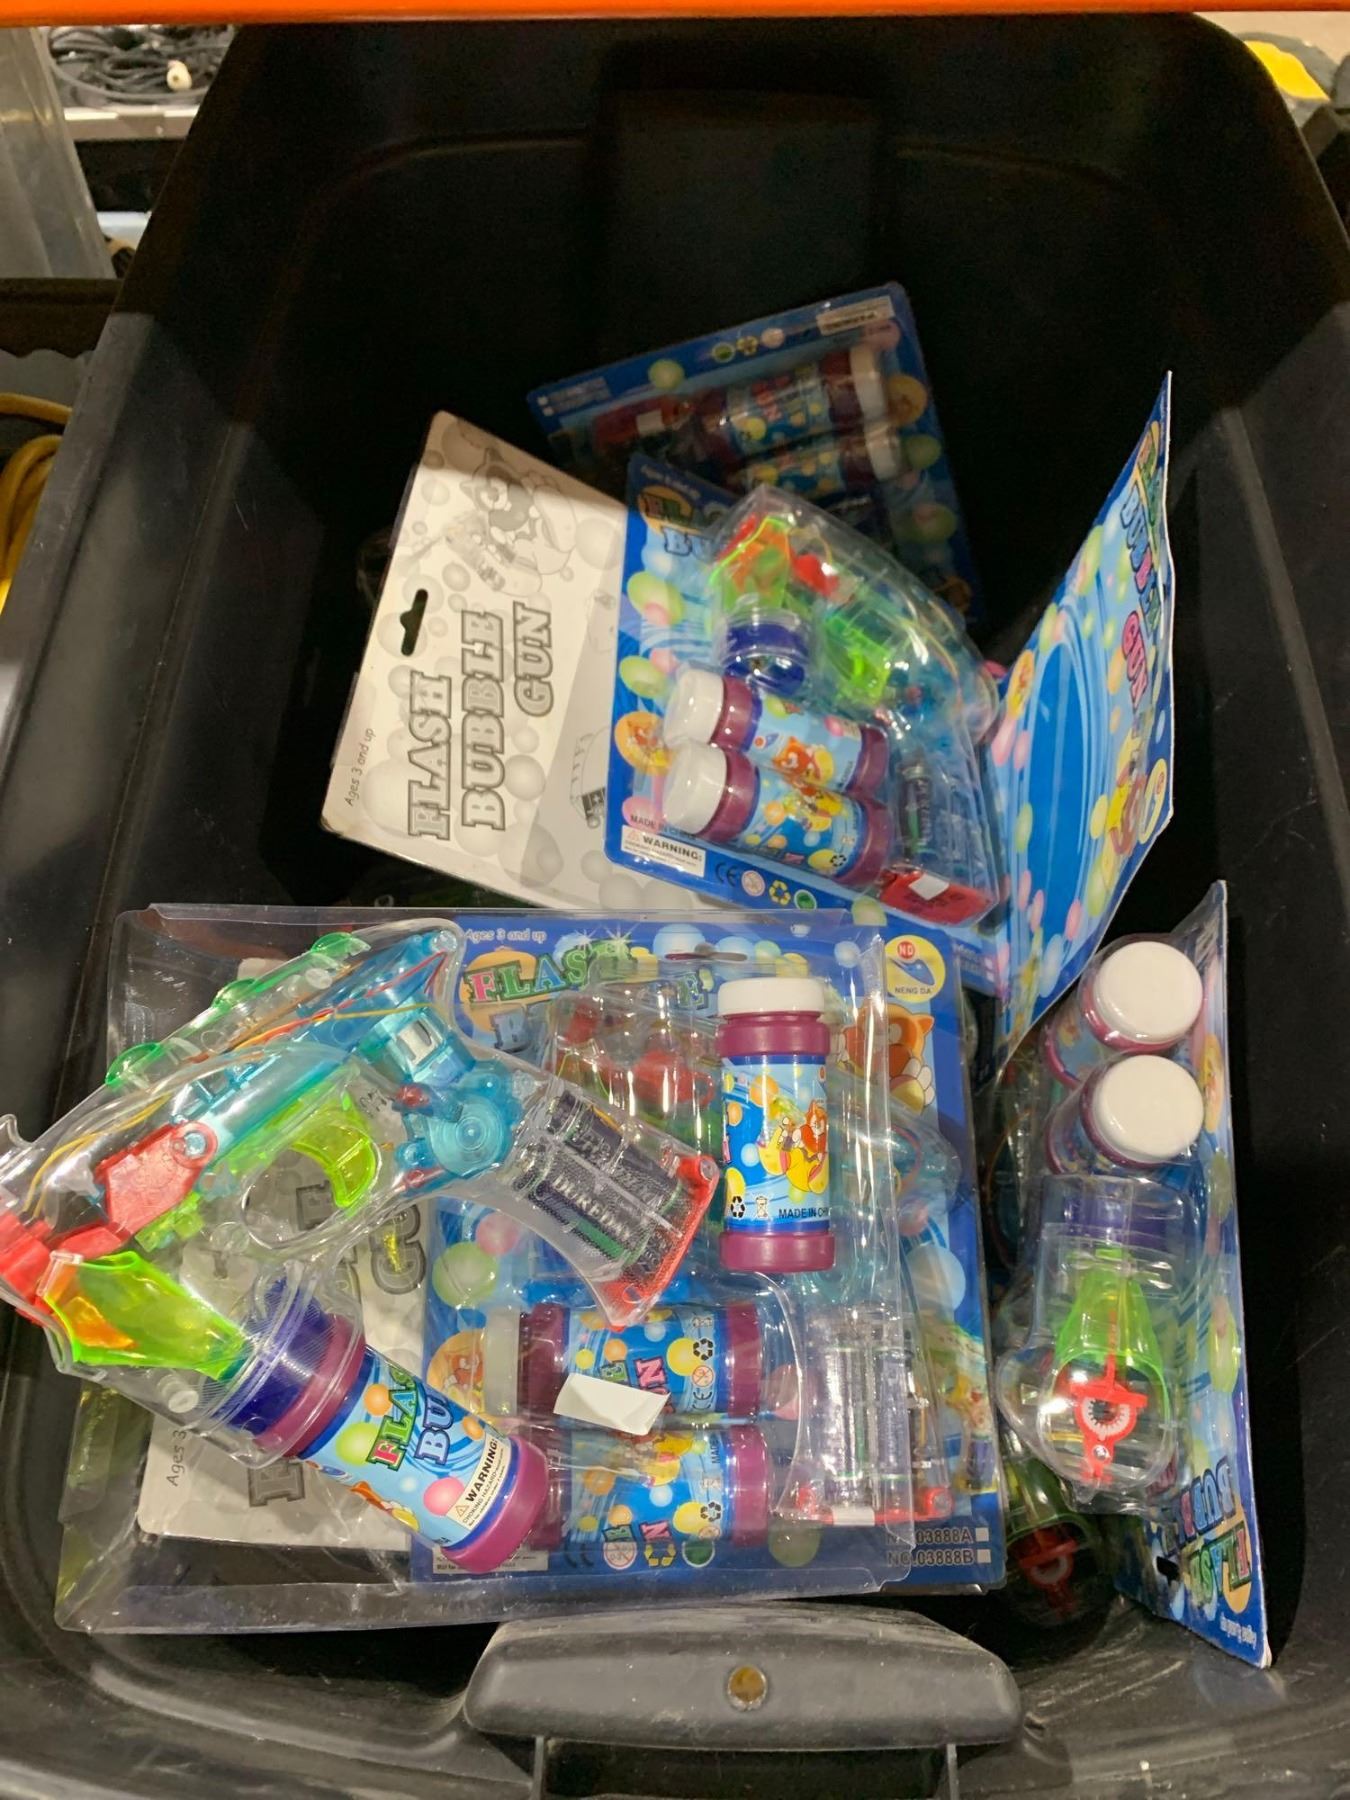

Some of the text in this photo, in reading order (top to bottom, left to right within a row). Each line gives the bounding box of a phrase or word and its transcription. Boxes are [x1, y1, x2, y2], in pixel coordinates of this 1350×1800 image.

[513, 600, 555, 717] GUN
[461, 609, 506, 831] BUBBLE
[344, 728, 376, 807] Ages 3 and up
[408, 670, 452, 841] FLASH
[642, 835, 702, 862] WARNING:
[465, 928, 495, 944] Ages
[507, 927, 530, 941] and
[531, 930, 547, 944] up
[894, 986, 932, 995] NENG DA
[778, 1208, 806, 1219] MADE
[808, 1207, 817, 1217] IN
[166, 1429, 187, 1487] Ages 3
[465, 1439, 498, 1503] WARNING:
